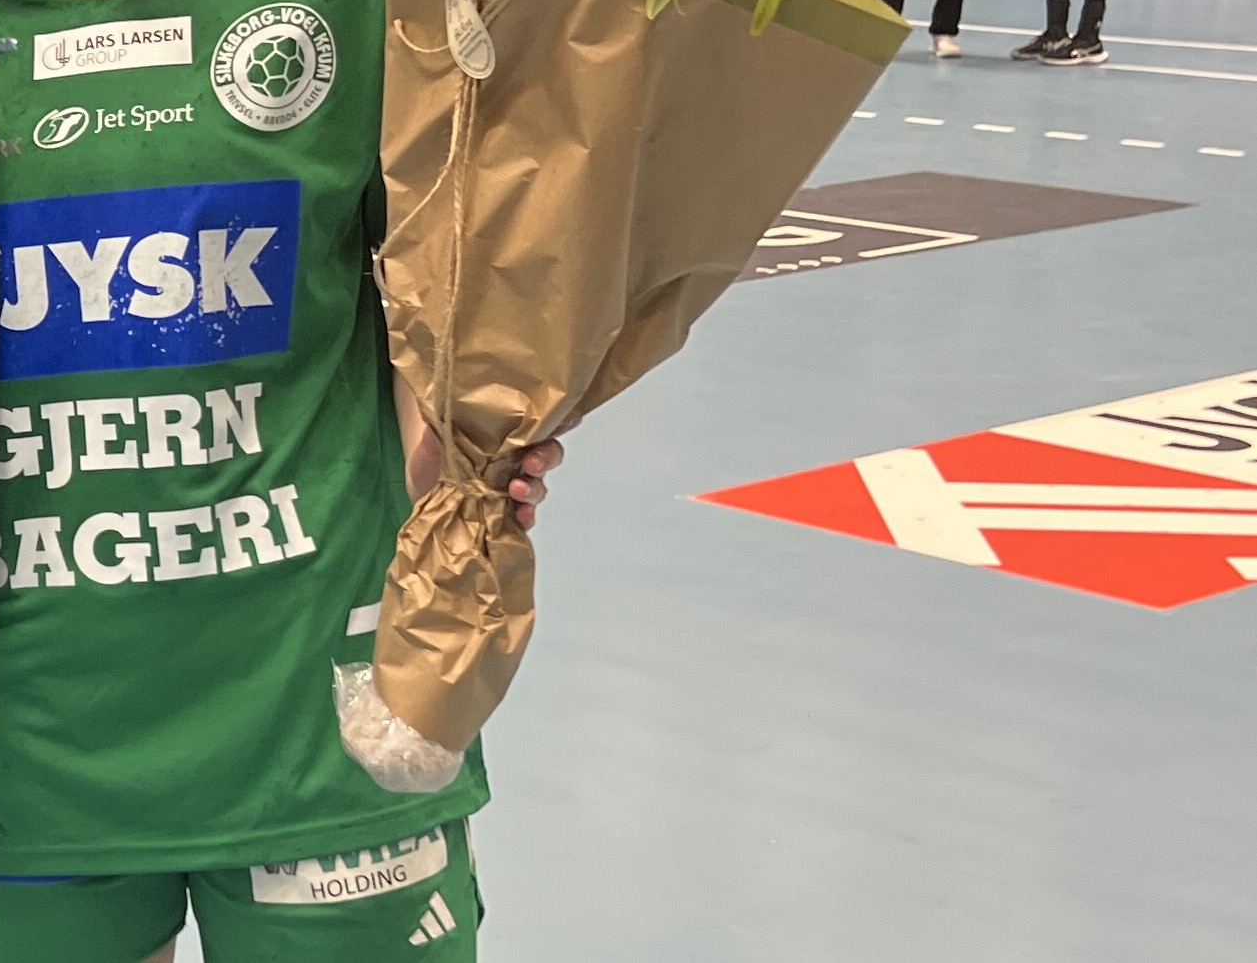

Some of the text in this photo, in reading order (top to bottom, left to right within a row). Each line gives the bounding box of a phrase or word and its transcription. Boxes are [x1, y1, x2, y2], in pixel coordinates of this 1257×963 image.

[76, 28, 184, 52] LARS LARSEN
[312, 32, 333, 80] KFUM
[75, 48, 127, 67] GROUP
[94, 103, 194, 134] Jet Sport
[0, 226, 278, 331] JYSK
[310, 864, 407, 899] HOLDING
